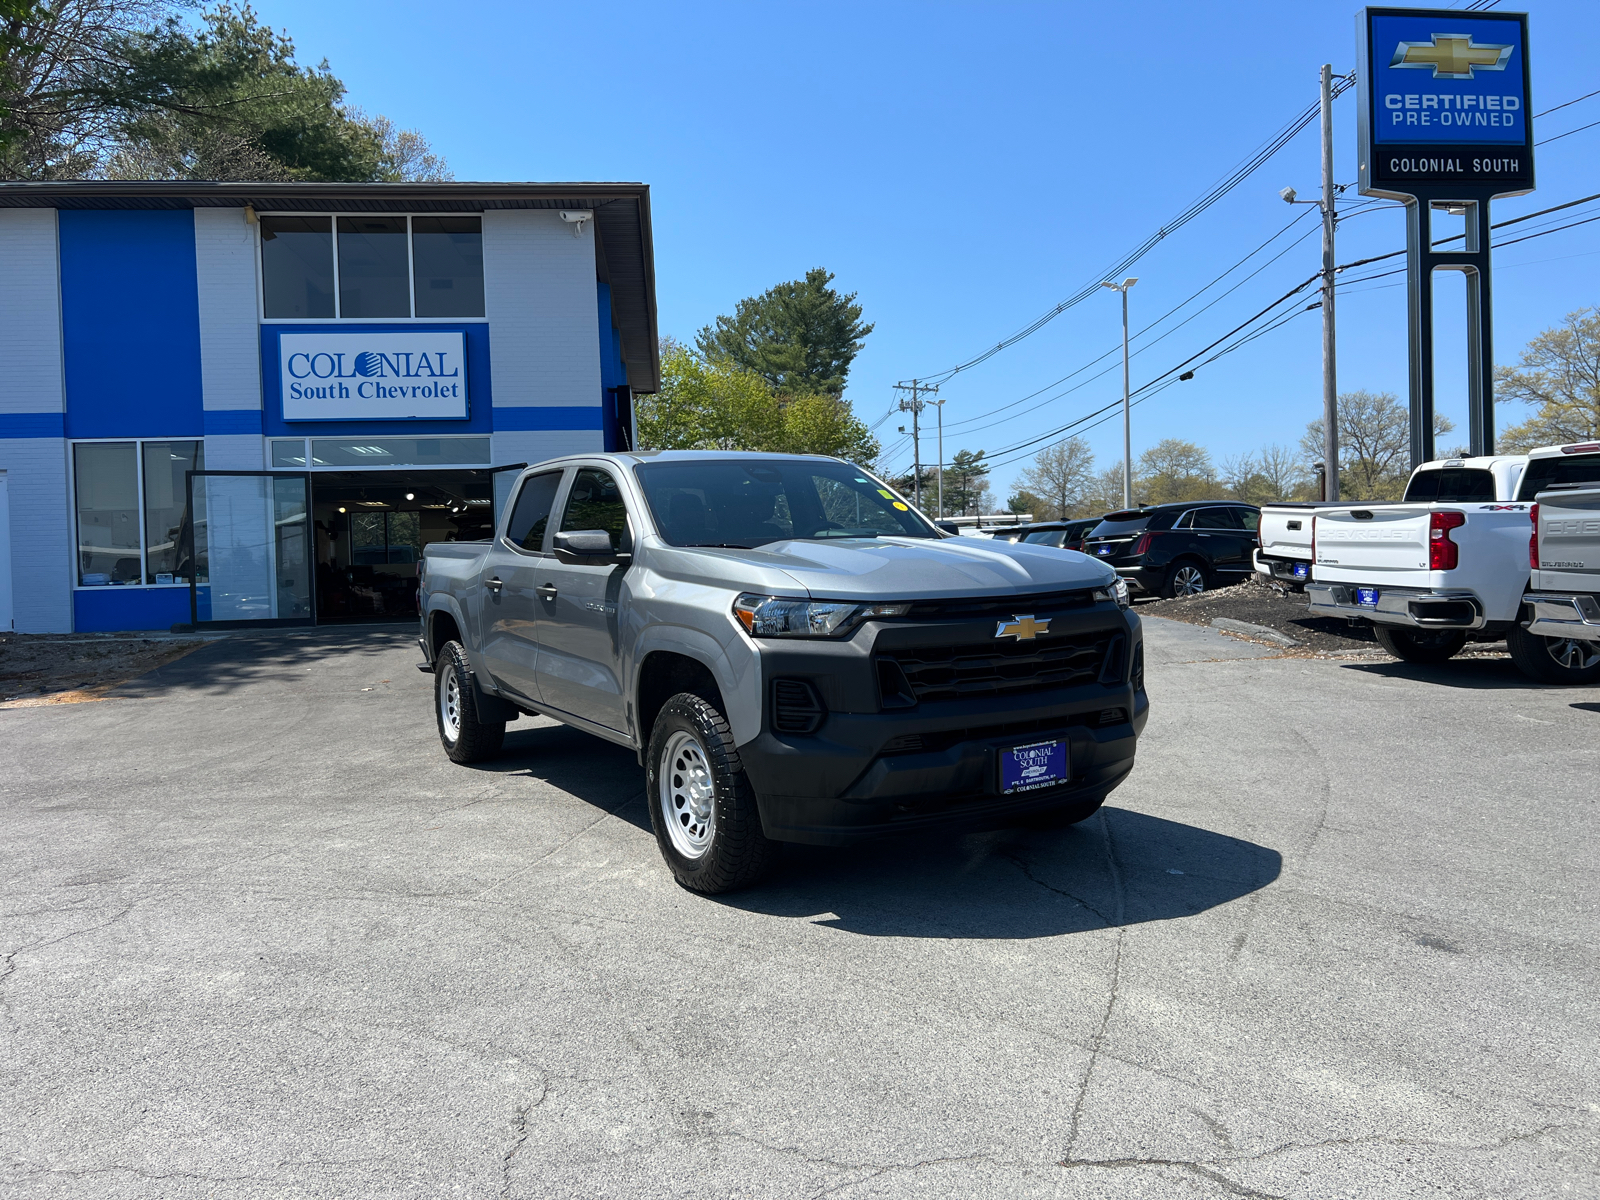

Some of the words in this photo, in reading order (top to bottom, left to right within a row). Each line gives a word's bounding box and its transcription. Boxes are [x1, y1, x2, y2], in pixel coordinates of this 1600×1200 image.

[1384, 94, 1520, 111] CERTIFIED
[1392, 111, 1514, 127] PRE-OWNED
[1390, 158, 1464, 173] COLONIAL
[1472, 158, 1519, 173] SOUTH
[287, 351, 459, 379] COLONIAL
[290, 381, 350, 400] South
[357, 381, 459, 399] Chevrolet
[1318, 528, 1417, 541] CHEVROLET
[1014, 748, 1054, 760] COLONIAL
[1020, 756, 1048, 768] SOUTH
[1016, 784, 1040, 792] COLONIAL
